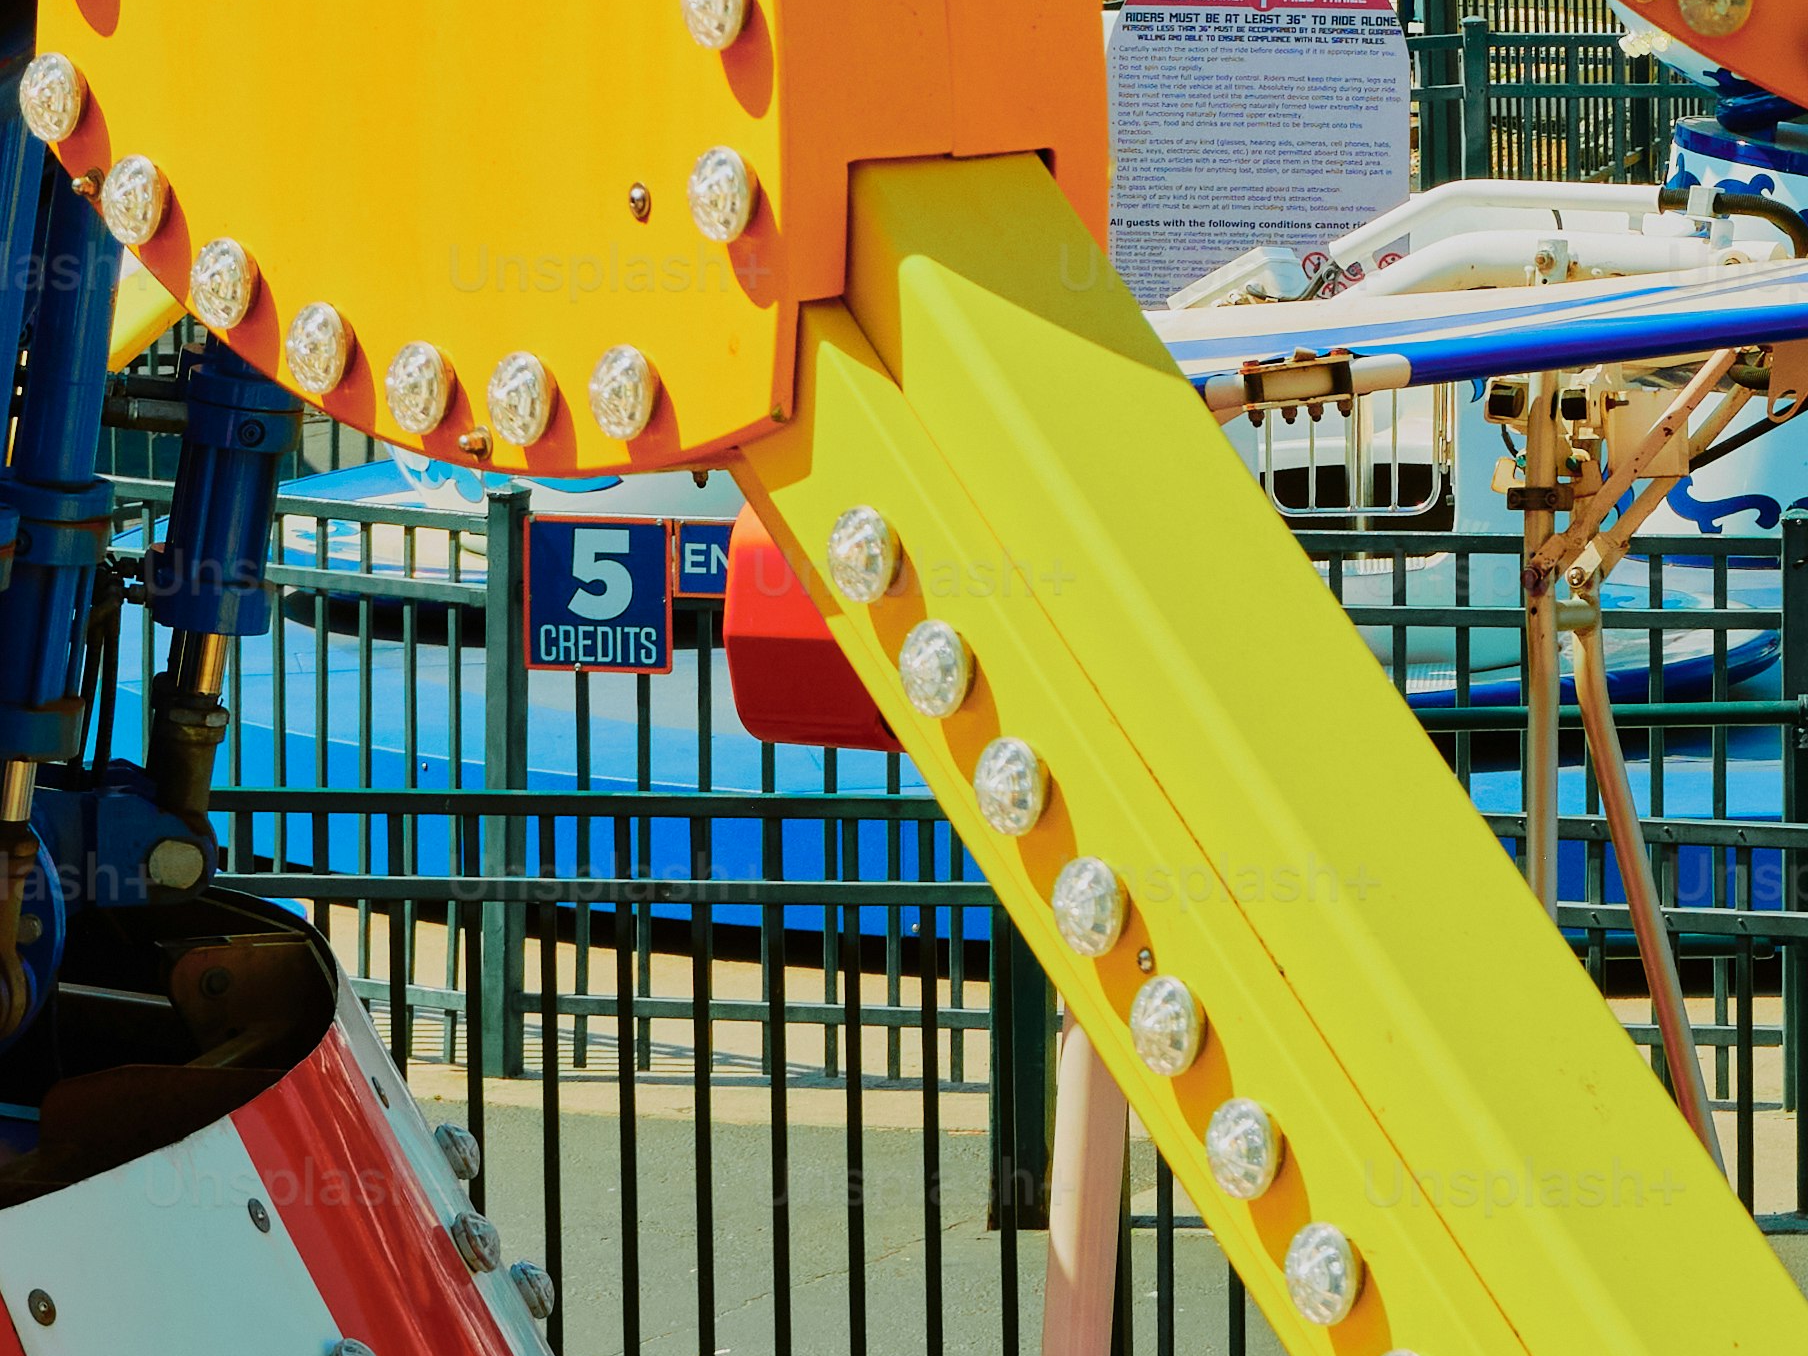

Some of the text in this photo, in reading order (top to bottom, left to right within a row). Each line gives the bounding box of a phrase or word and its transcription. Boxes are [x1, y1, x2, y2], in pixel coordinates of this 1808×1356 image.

[1125, 12, 1400, 26] RIDERS MUST BE AT LEAST 36" TO RIDE ALONE.
[1216, 74, 1233, 82] body
[1367, 76, 1381, 84] legs
[1127, 219, 1160, 228] guests
[1163, 219, 1186, 227] with
[1209, 220, 1255, 229] following
[1259, 220, 1312, 229] conditions
[1315, 221, 1350, 229] cannot
[567, 528, 633, 621] 5
[539, 624, 657, 664] CREDITS
